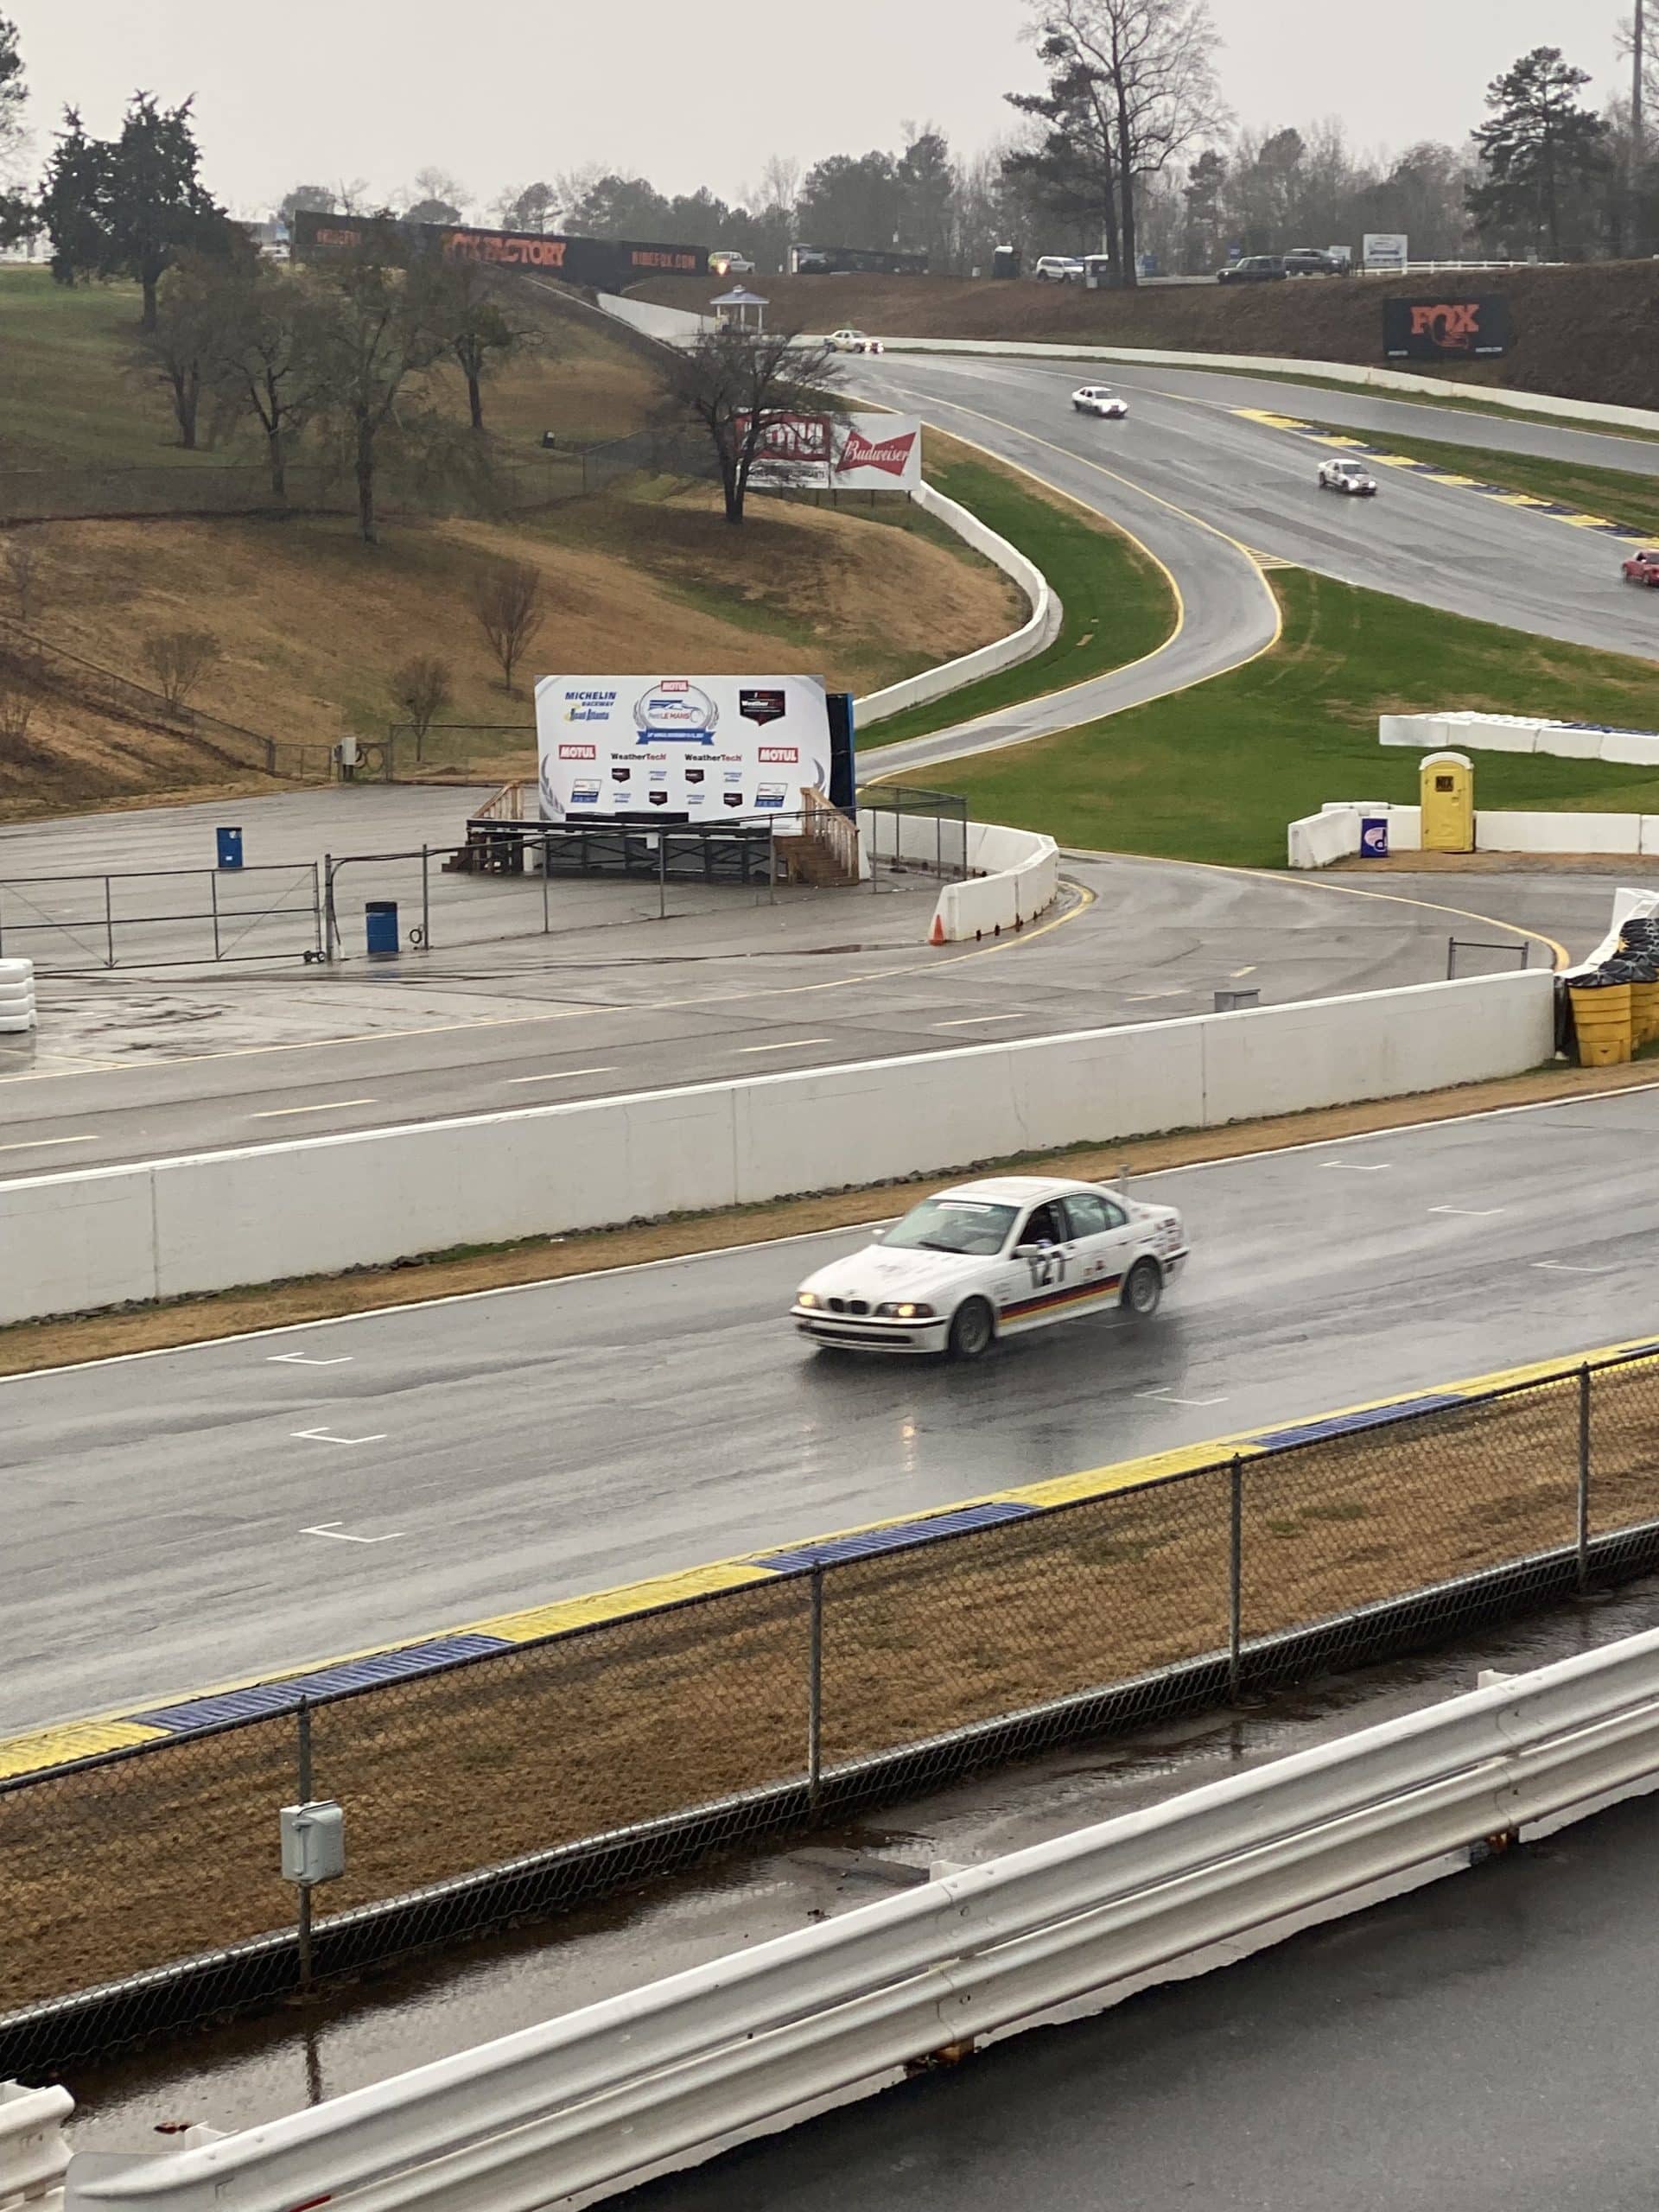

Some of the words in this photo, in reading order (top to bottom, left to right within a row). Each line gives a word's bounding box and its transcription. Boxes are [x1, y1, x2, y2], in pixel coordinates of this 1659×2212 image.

[1410, 304, 1479, 340] FOX
[843, 439, 909, 463] Budweiser
[564, 691, 617, 700] MICHELIN
[560, 746, 594, 759] MOTUL
[760, 748, 798, 761] MOTUL
